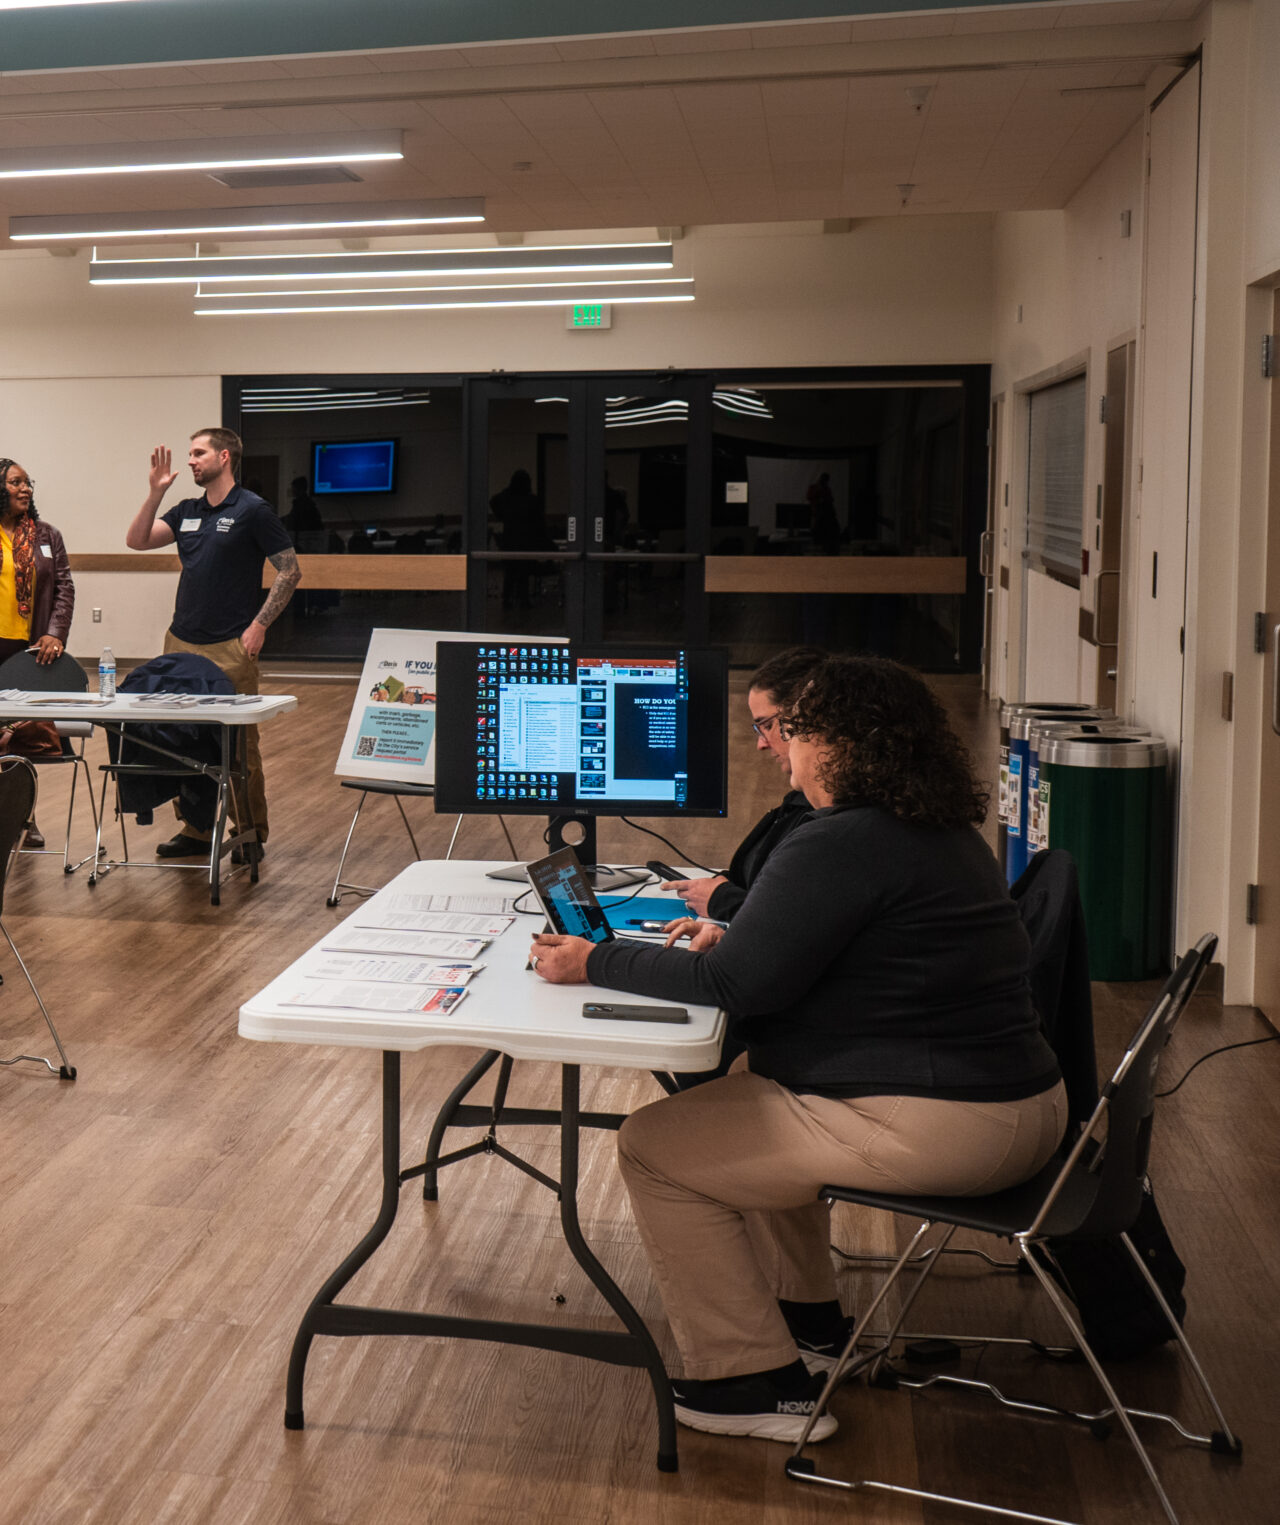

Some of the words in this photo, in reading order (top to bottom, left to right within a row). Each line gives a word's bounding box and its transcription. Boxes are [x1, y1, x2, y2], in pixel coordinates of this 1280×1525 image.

[574, 305, 602, 326] EXIT
[415, 661, 433, 669] YOU
[777, 1400, 818, 1413] HOKA
